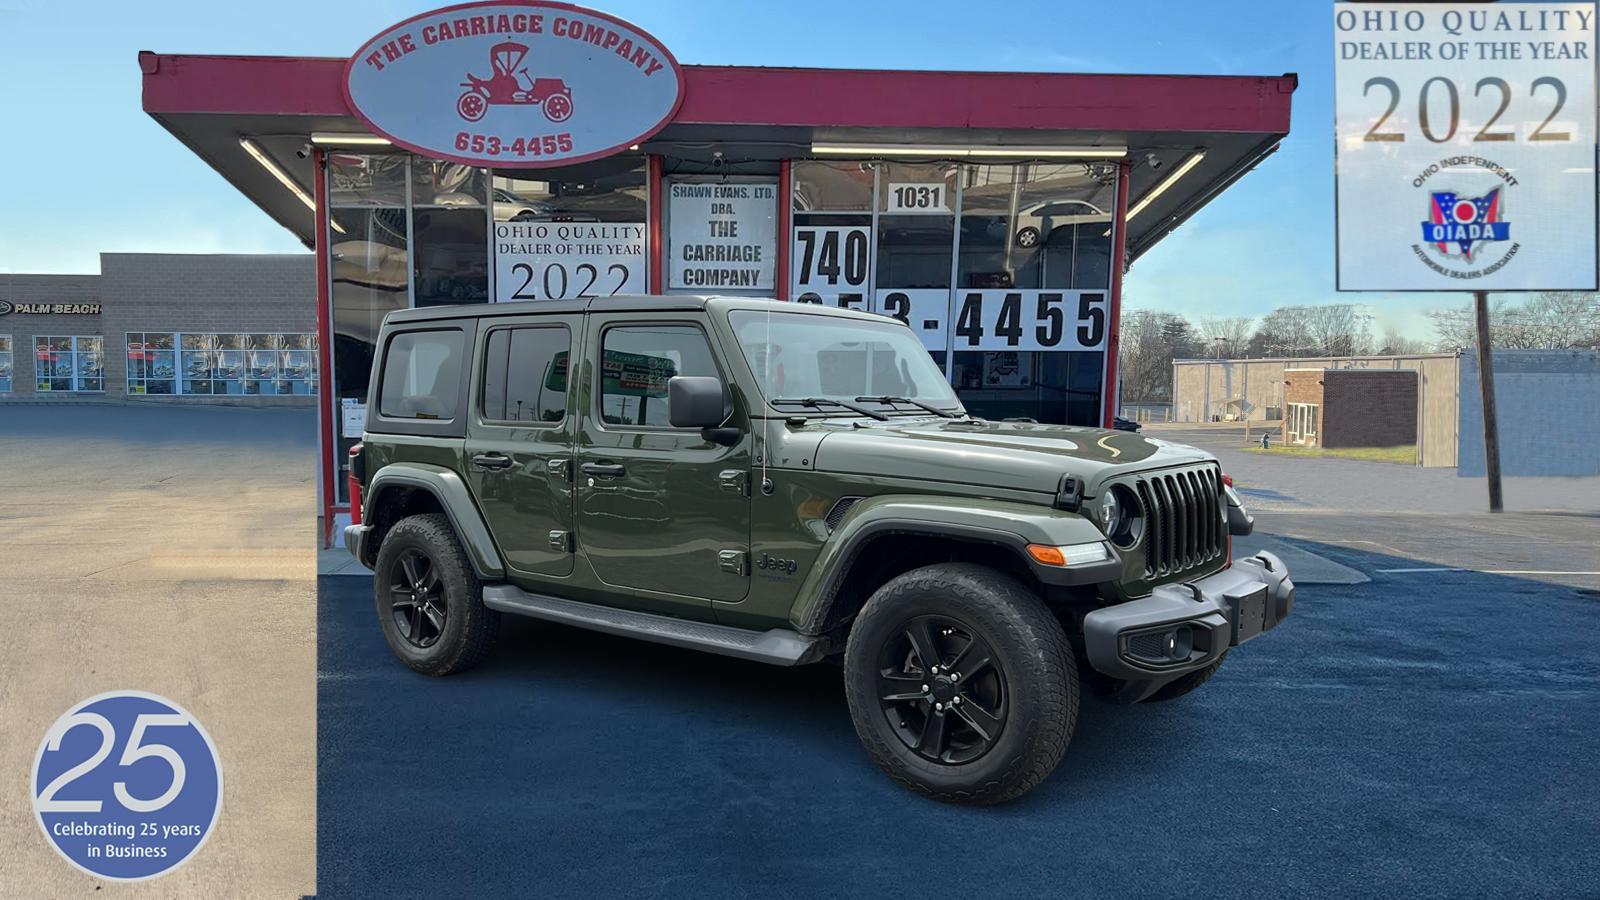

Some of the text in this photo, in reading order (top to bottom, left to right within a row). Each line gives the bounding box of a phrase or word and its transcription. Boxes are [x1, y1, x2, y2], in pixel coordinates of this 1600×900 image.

[1336, 10, 1593, 36] OHIO QUALITY
[365, 14, 664, 77] THE CARRIAGE COMPANY
[1341, 42, 1589, 60] DEALER OF THE YEAR
[1363, 76, 1572, 143] 2022
[454, 132, 573, 157] 653-4455
[1412, 155, 1519, 188] OHIO INDEPENDENT
[672, 185, 712, 198] SHAWN
[754, 187, 775, 200] LTD.
[894, 186, 941, 208] 1031
[711, 203, 736, 215] DBA.
[496, 226, 644, 241] OHIO QUALITY
[708, 220, 738, 238] THE
[1432, 224, 1496, 241] OIADA
[500, 243, 642, 256] DEALER OF THE YEAR
[683, 244, 762, 262] CARRIAGE
[797, 230, 867, 286] 740
[1410, 241, 1521, 280] AUTOMOBILE DEALERS ASSOCIATION
[511, 262, 630, 300] 2022
[683, 268, 761, 286] COMPANY
[14, 303, 101, 314] PALM BEACH
[756, 552, 798, 575] Jeep
